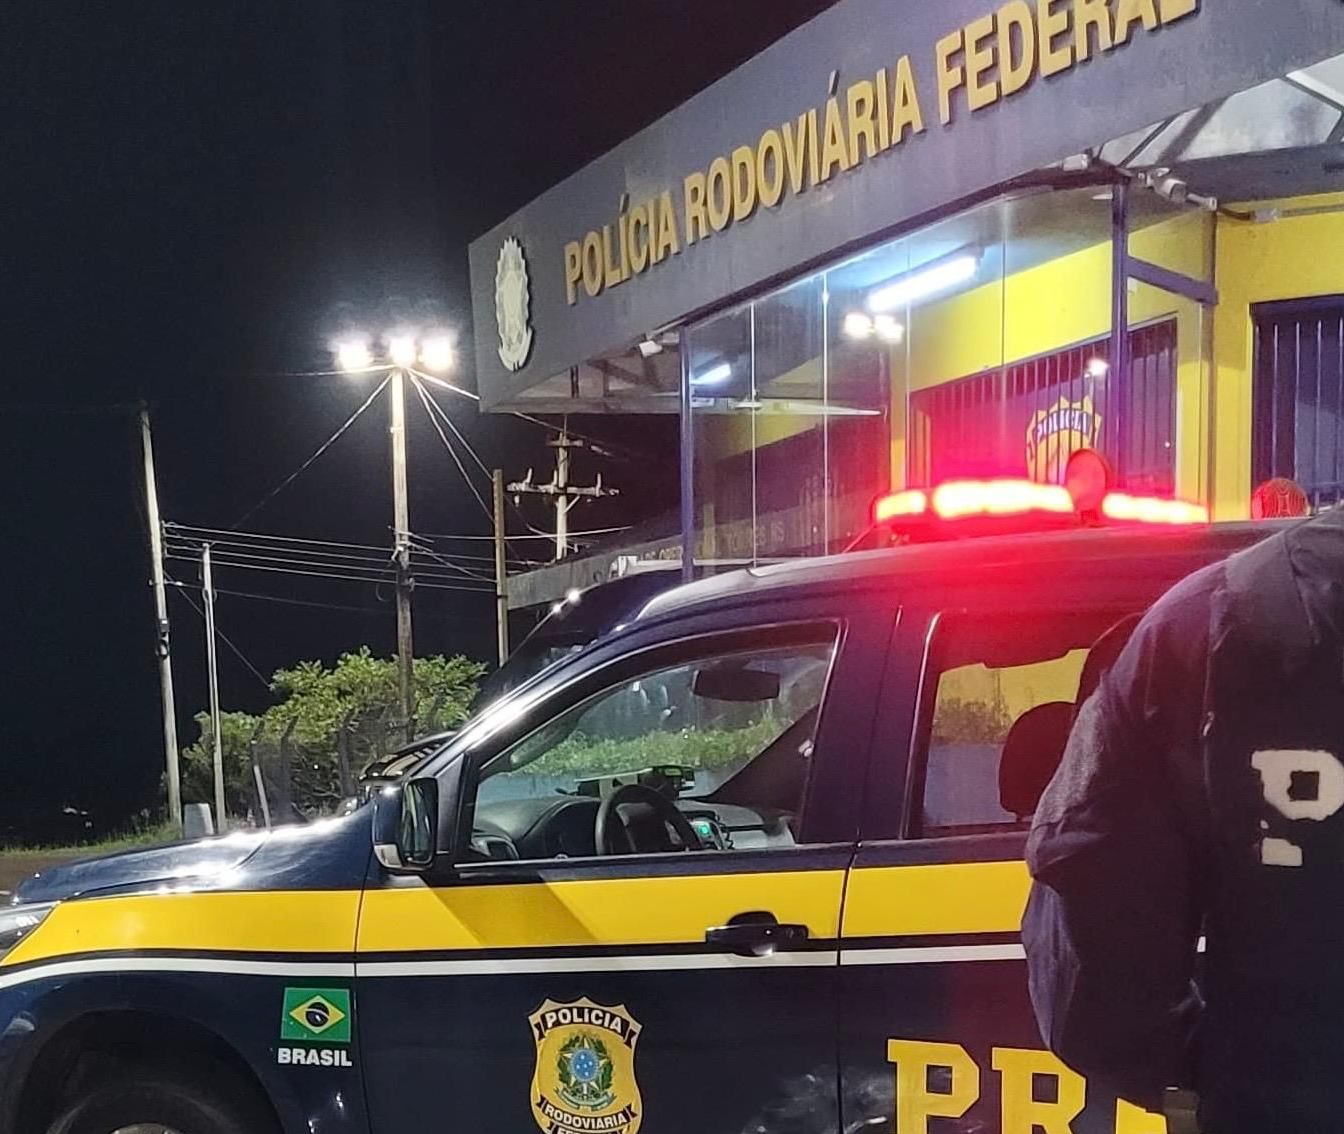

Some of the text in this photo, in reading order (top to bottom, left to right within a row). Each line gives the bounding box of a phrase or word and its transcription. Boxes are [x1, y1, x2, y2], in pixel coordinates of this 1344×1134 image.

[563, 194, 681, 305] POLÍCIA
[684, 55, 925, 245] RODOVIÁRIA
[277, 1047, 353, 1067] BRASIL
